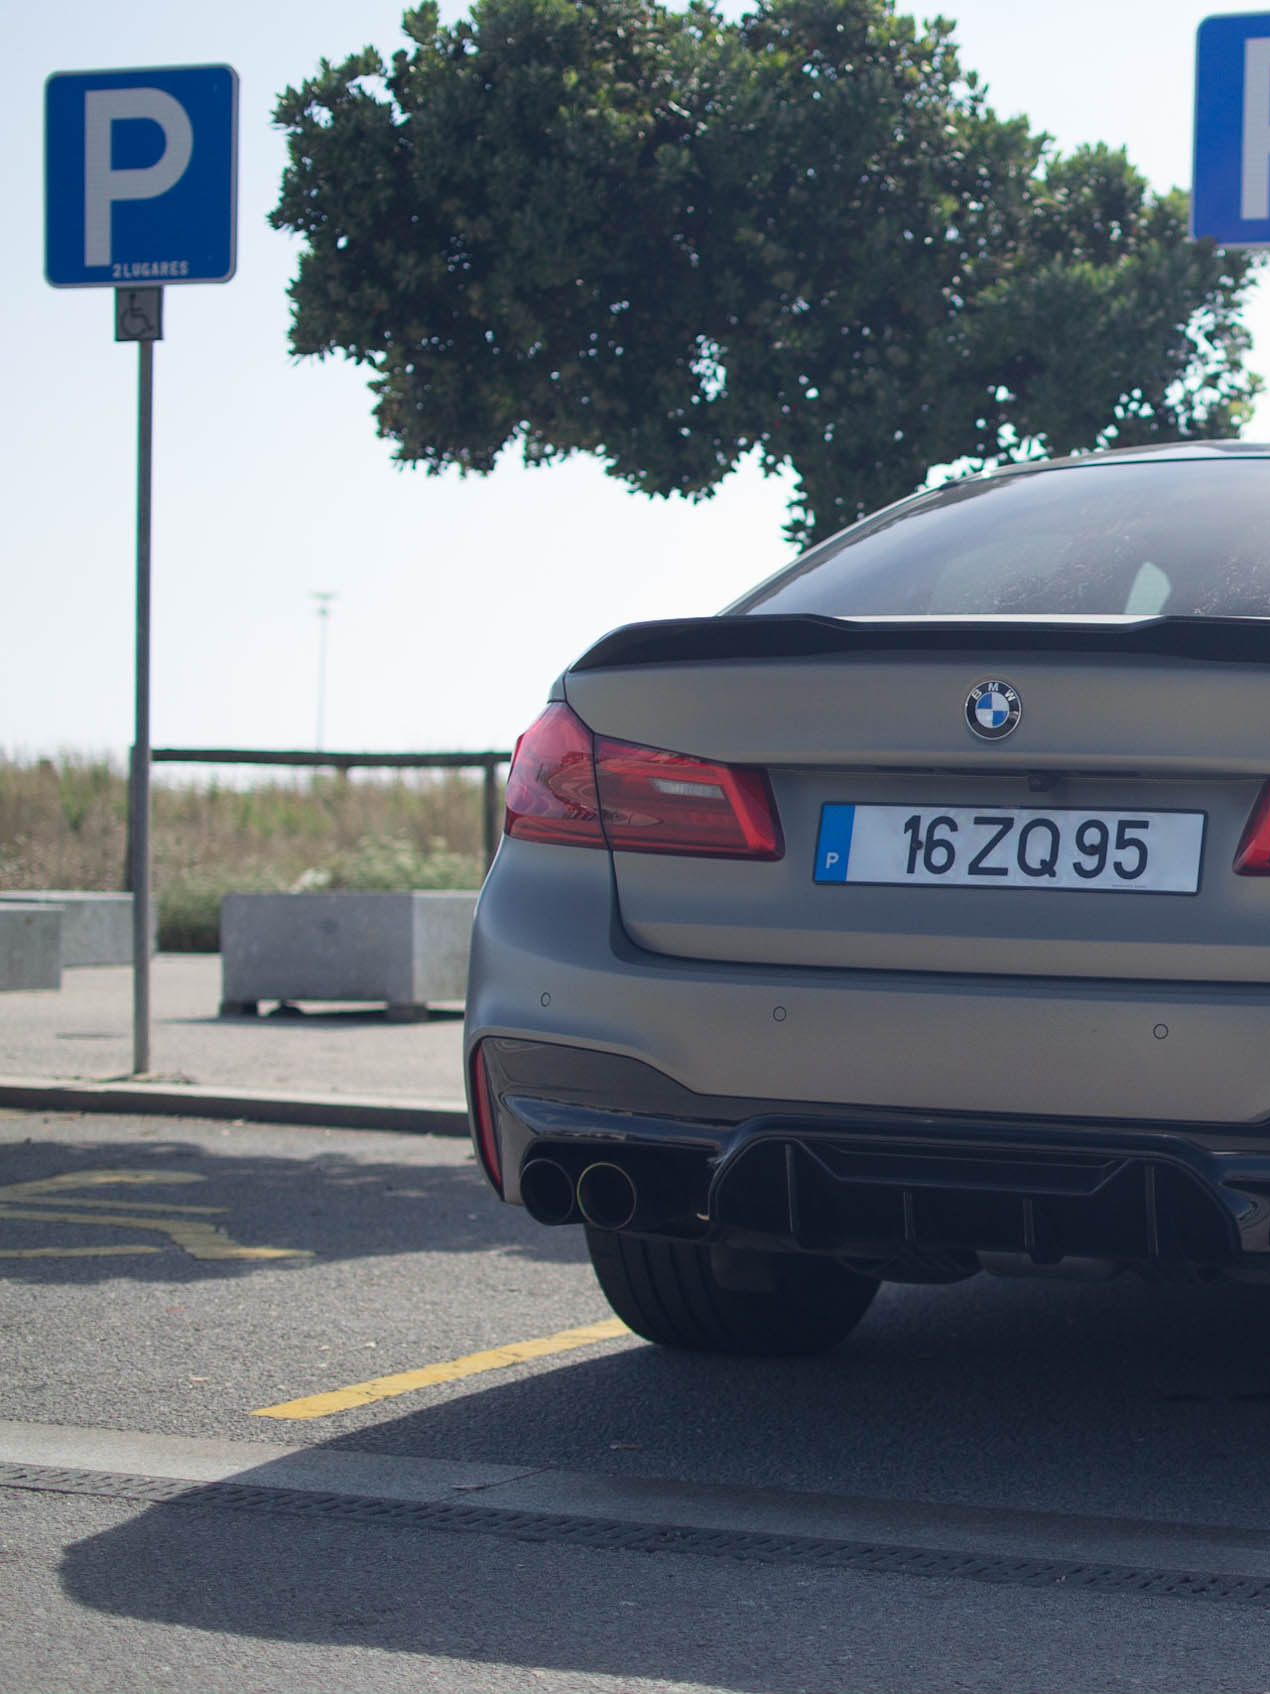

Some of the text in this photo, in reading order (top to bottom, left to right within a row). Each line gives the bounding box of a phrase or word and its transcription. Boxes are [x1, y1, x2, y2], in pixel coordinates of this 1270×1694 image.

[84, 87, 194, 267] P
[971, 682, 1017, 701] BMW
[825, 852, 839, 869] P
